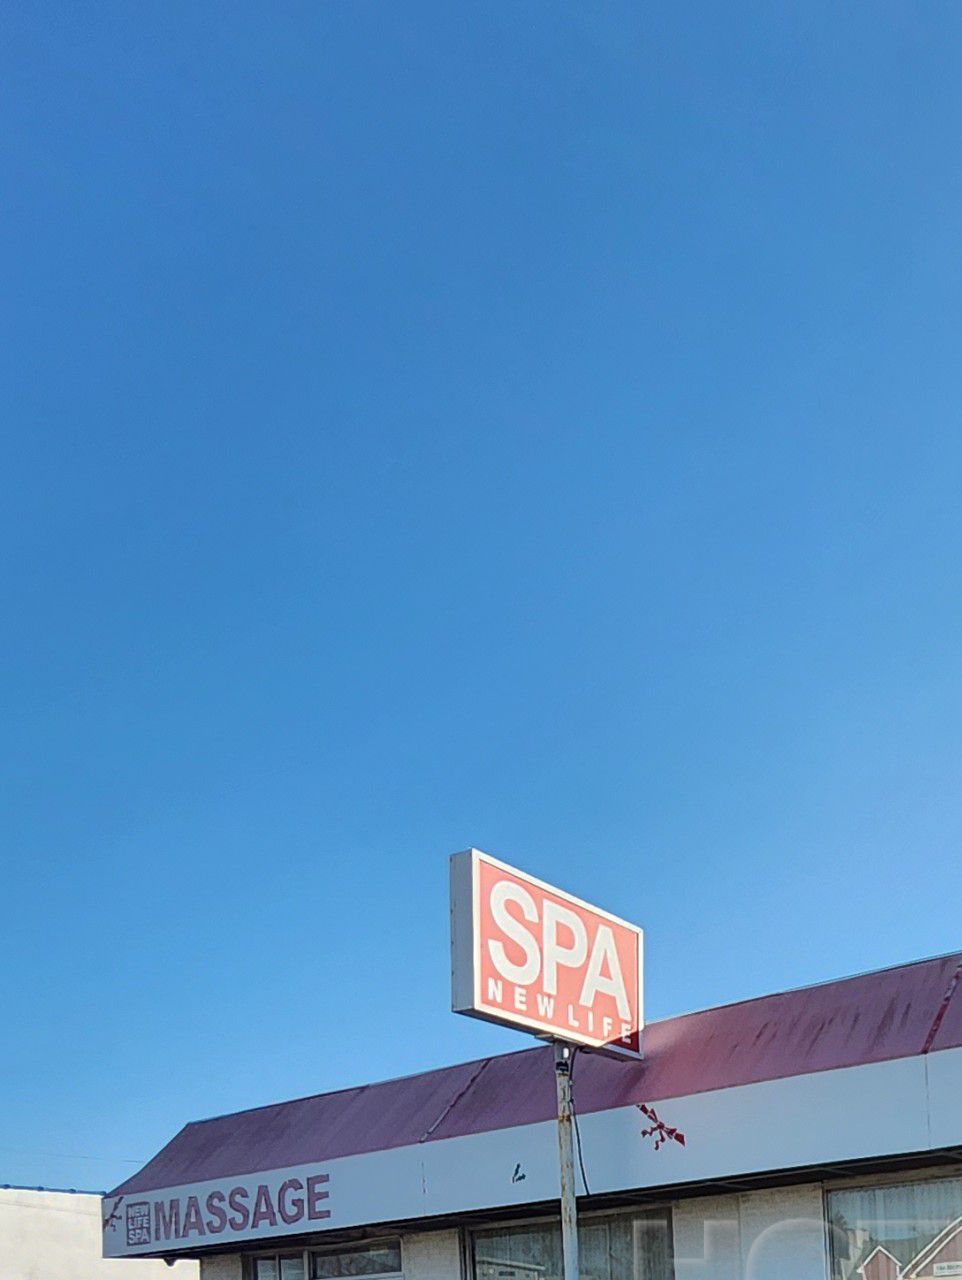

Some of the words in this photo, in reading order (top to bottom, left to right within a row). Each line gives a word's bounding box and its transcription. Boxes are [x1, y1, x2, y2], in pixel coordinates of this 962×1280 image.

[488, 880, 632, 1021] SPA
[488, 977, 555, 1019] NEW
[567, 1004, 632, 1044] LIFE
[128, 1205, 149, 1217] NEW
[128, 1216, 149, 1229] LIFE
[155, 1174, 331, 1241] MASSAGE
[128, 1228, 150, 1244] SPA
